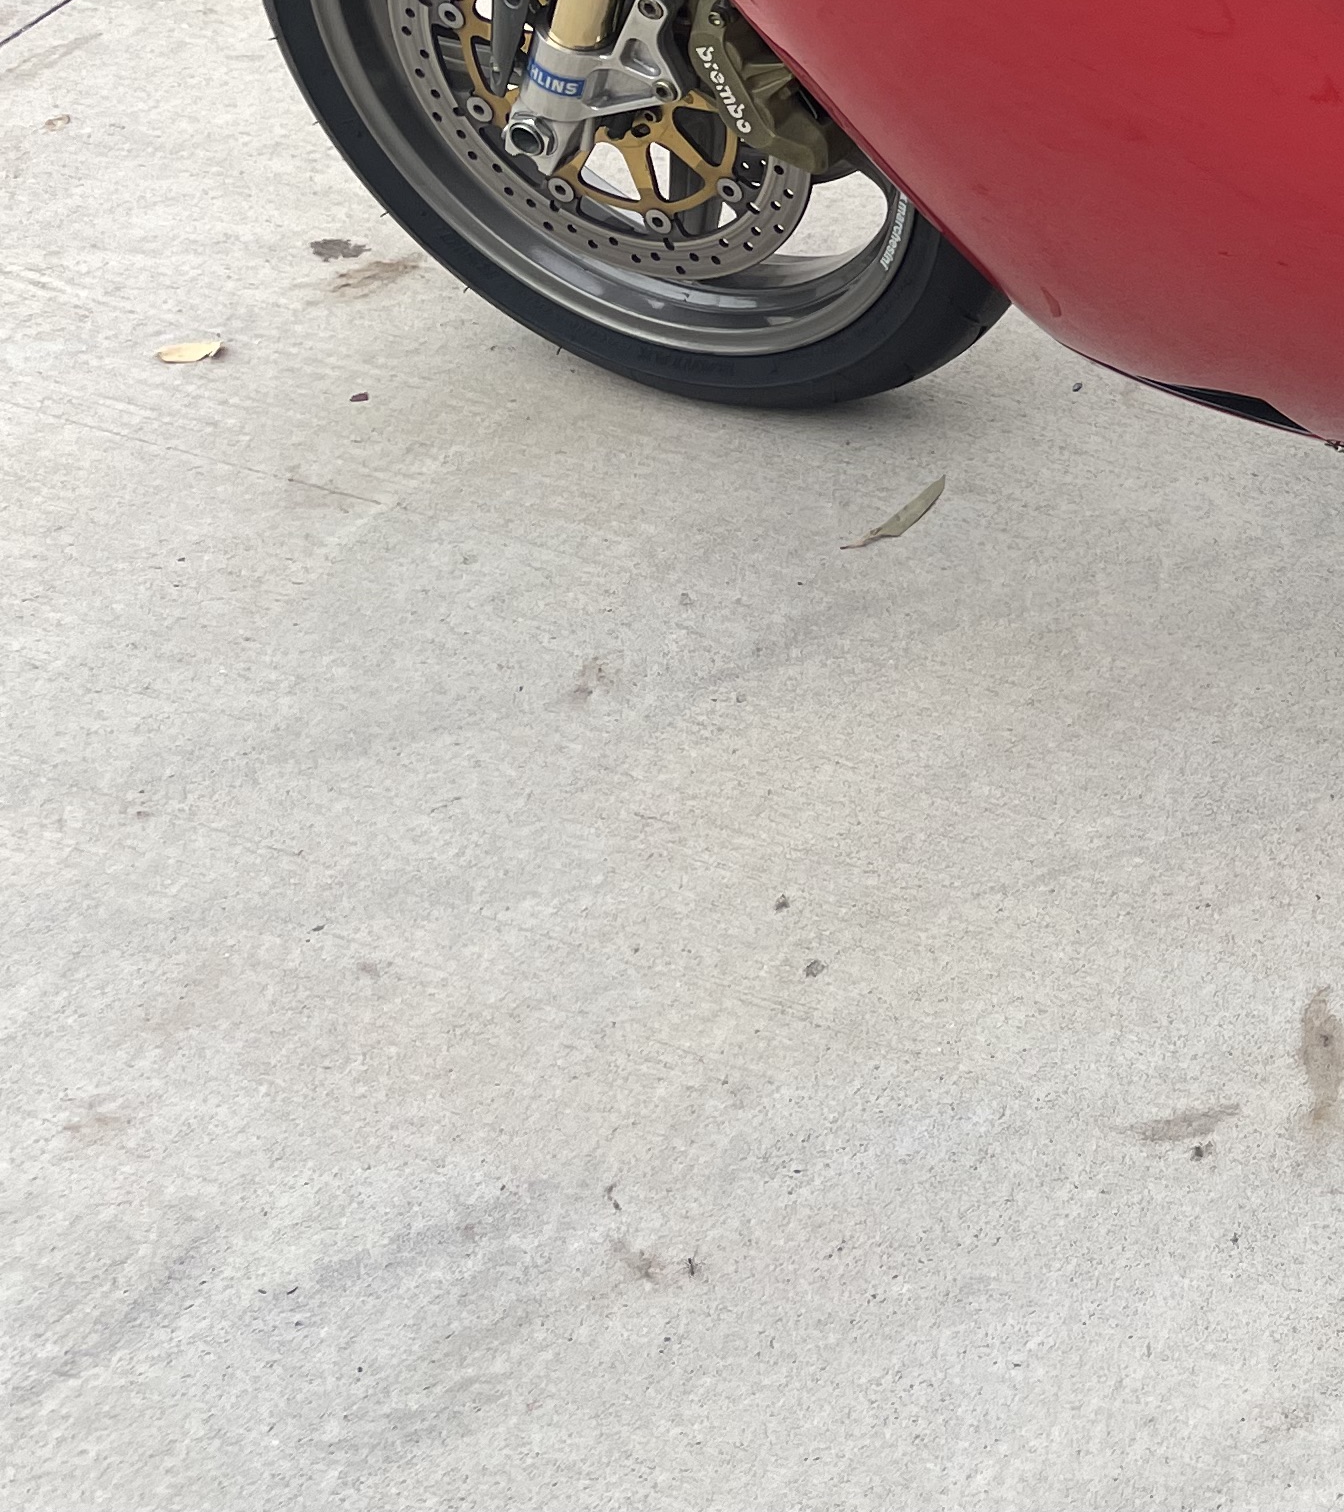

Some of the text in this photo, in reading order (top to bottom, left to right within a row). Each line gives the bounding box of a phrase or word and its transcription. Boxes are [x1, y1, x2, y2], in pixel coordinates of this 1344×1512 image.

[527, 62, 579, 96] HLINS
[695, 45, 752, 134] brembo
[879, 199, 907, 271] marchesini
